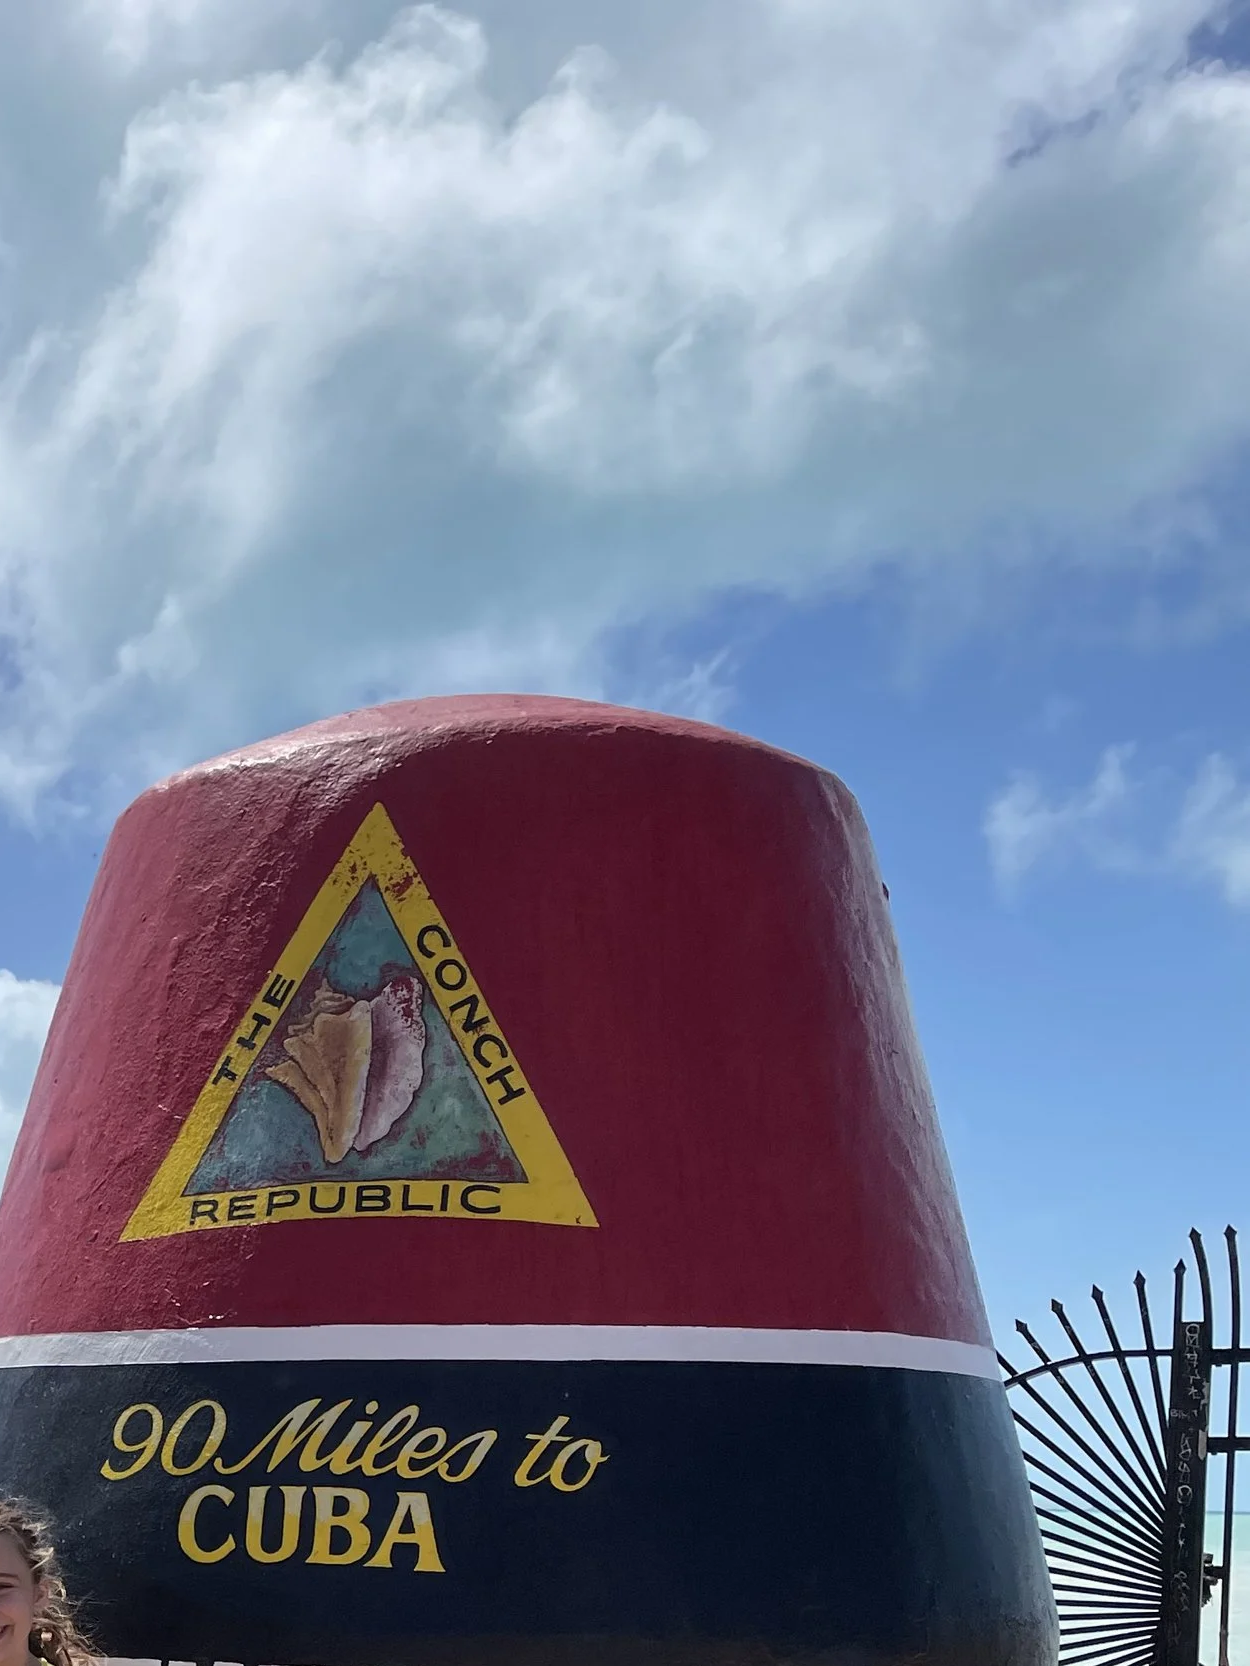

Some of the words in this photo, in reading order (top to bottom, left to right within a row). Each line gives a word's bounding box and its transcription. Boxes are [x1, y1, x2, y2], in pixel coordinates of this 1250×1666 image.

[211, 973, 295, 1086] THE
[416, 924, 527, 1106] CONCH
[189, 1184, 502, 1226] REPUBLIC
[100, 1399, 227, 1482] 90
[215, 1397, 498, 1484] Miles
[513, 1415, 611, 1493] to
[176, 1484, 447, 1573] CUBA
